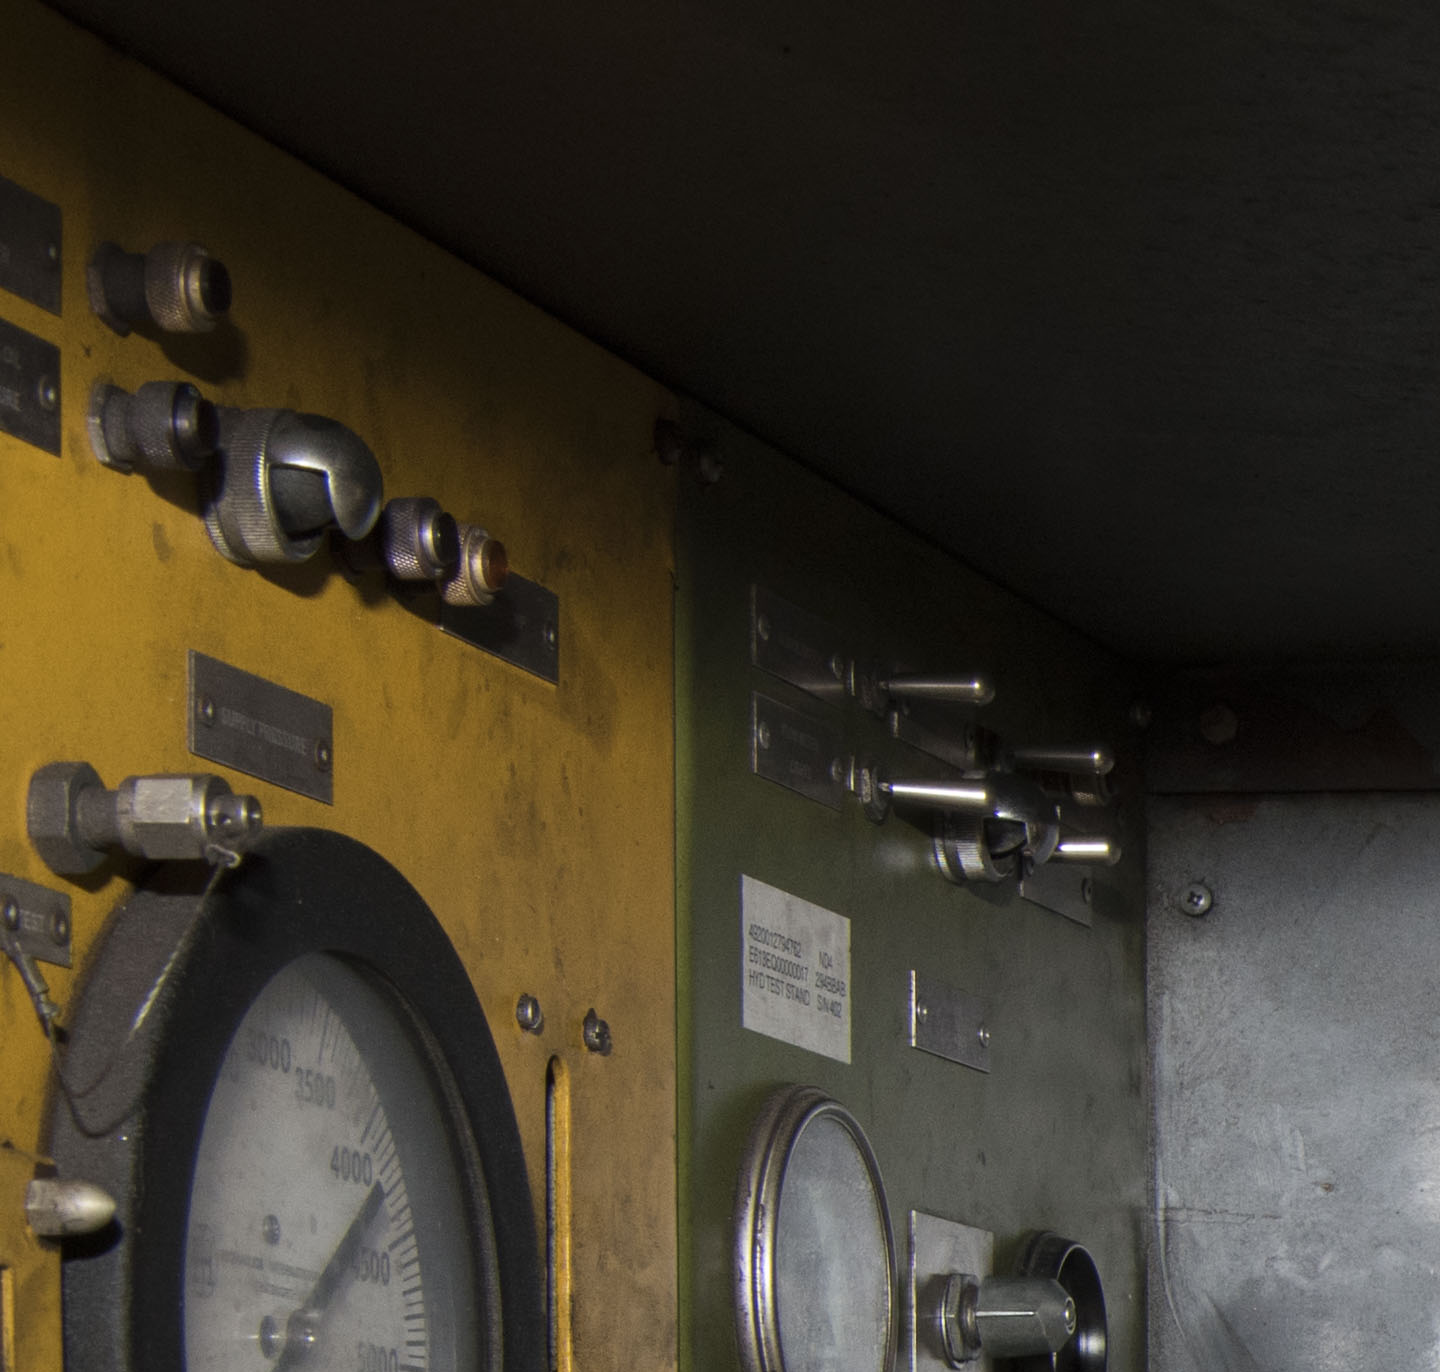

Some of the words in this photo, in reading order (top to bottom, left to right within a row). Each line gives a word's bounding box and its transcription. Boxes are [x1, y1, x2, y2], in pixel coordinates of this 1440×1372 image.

[749, 969, 765, 989] HYD
[766, 974, 785, 997] TEST
[786, 982, 811, 1006] STAND
[331, 1145, 373, 1187] 4000
